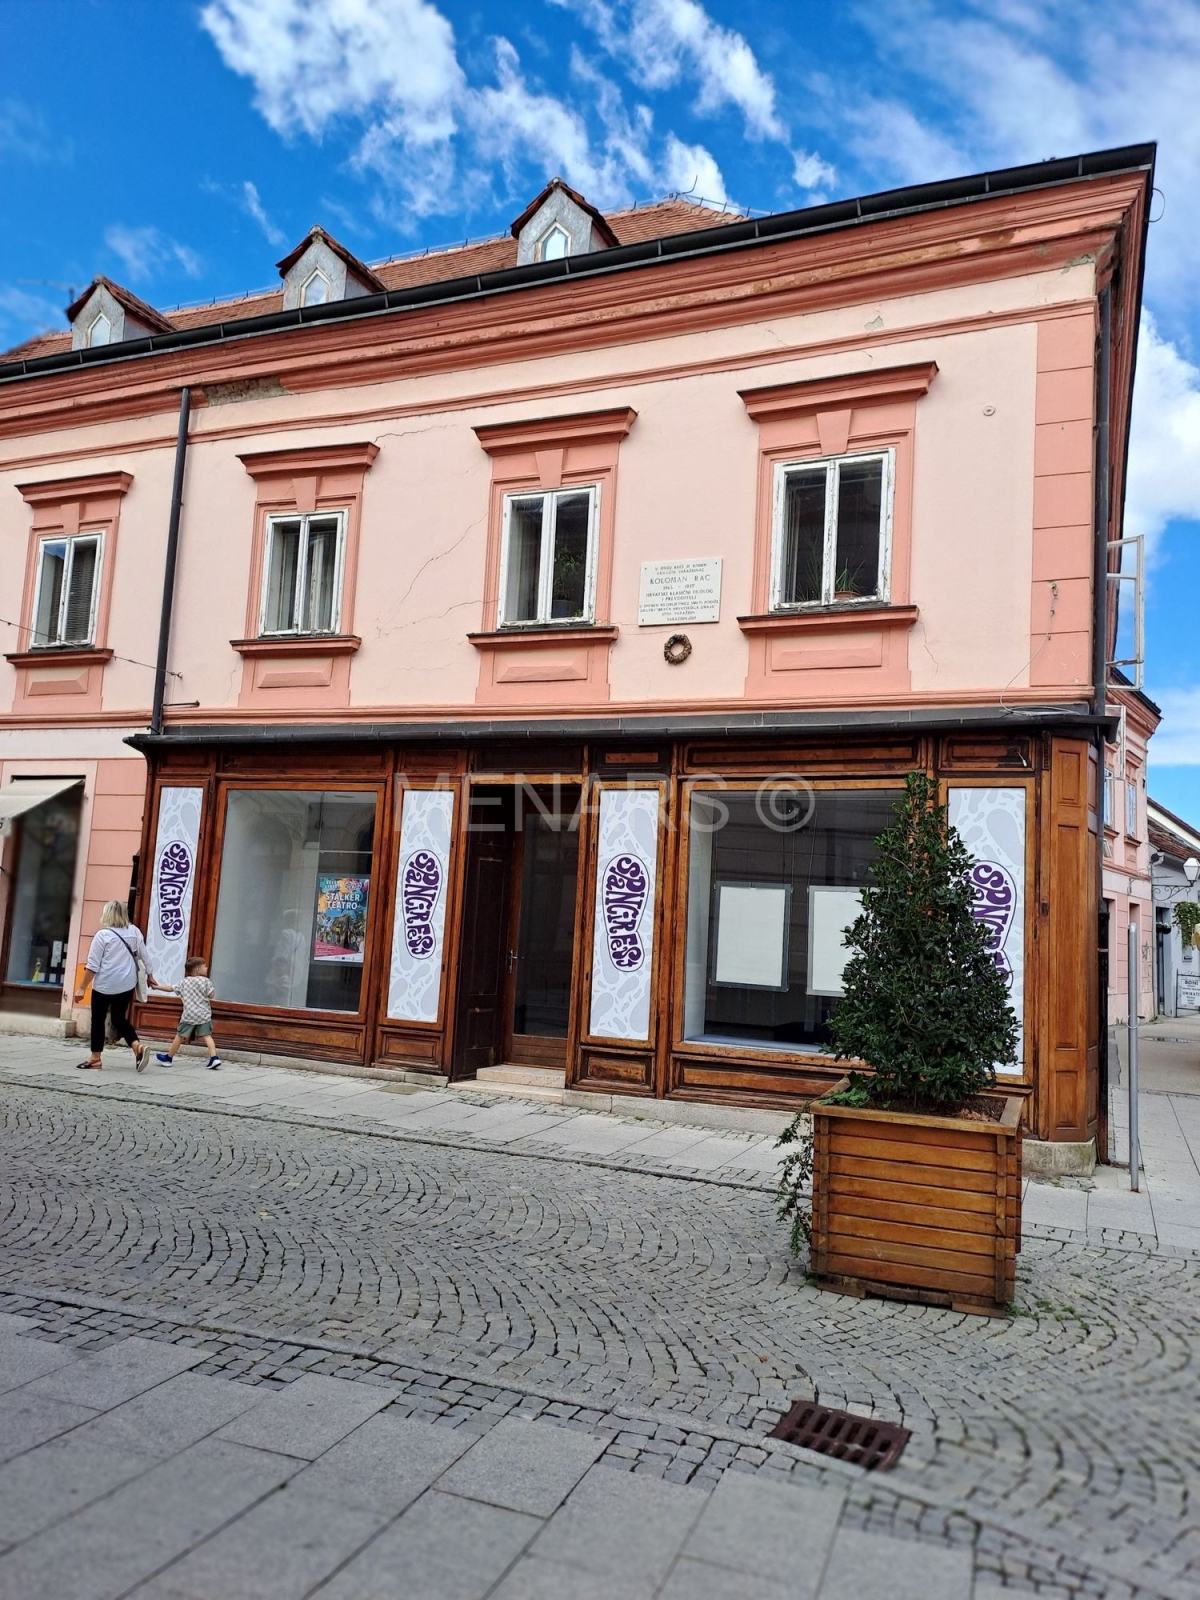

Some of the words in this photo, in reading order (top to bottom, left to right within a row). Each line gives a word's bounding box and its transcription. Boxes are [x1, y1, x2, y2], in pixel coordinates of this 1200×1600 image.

[650, 576, 687, 584] KOLOMAN
[694, 574, 711, 582] RAC
[326, 893, 360, 901] STALKER
[327, 902, 358, 910] TEATRO
